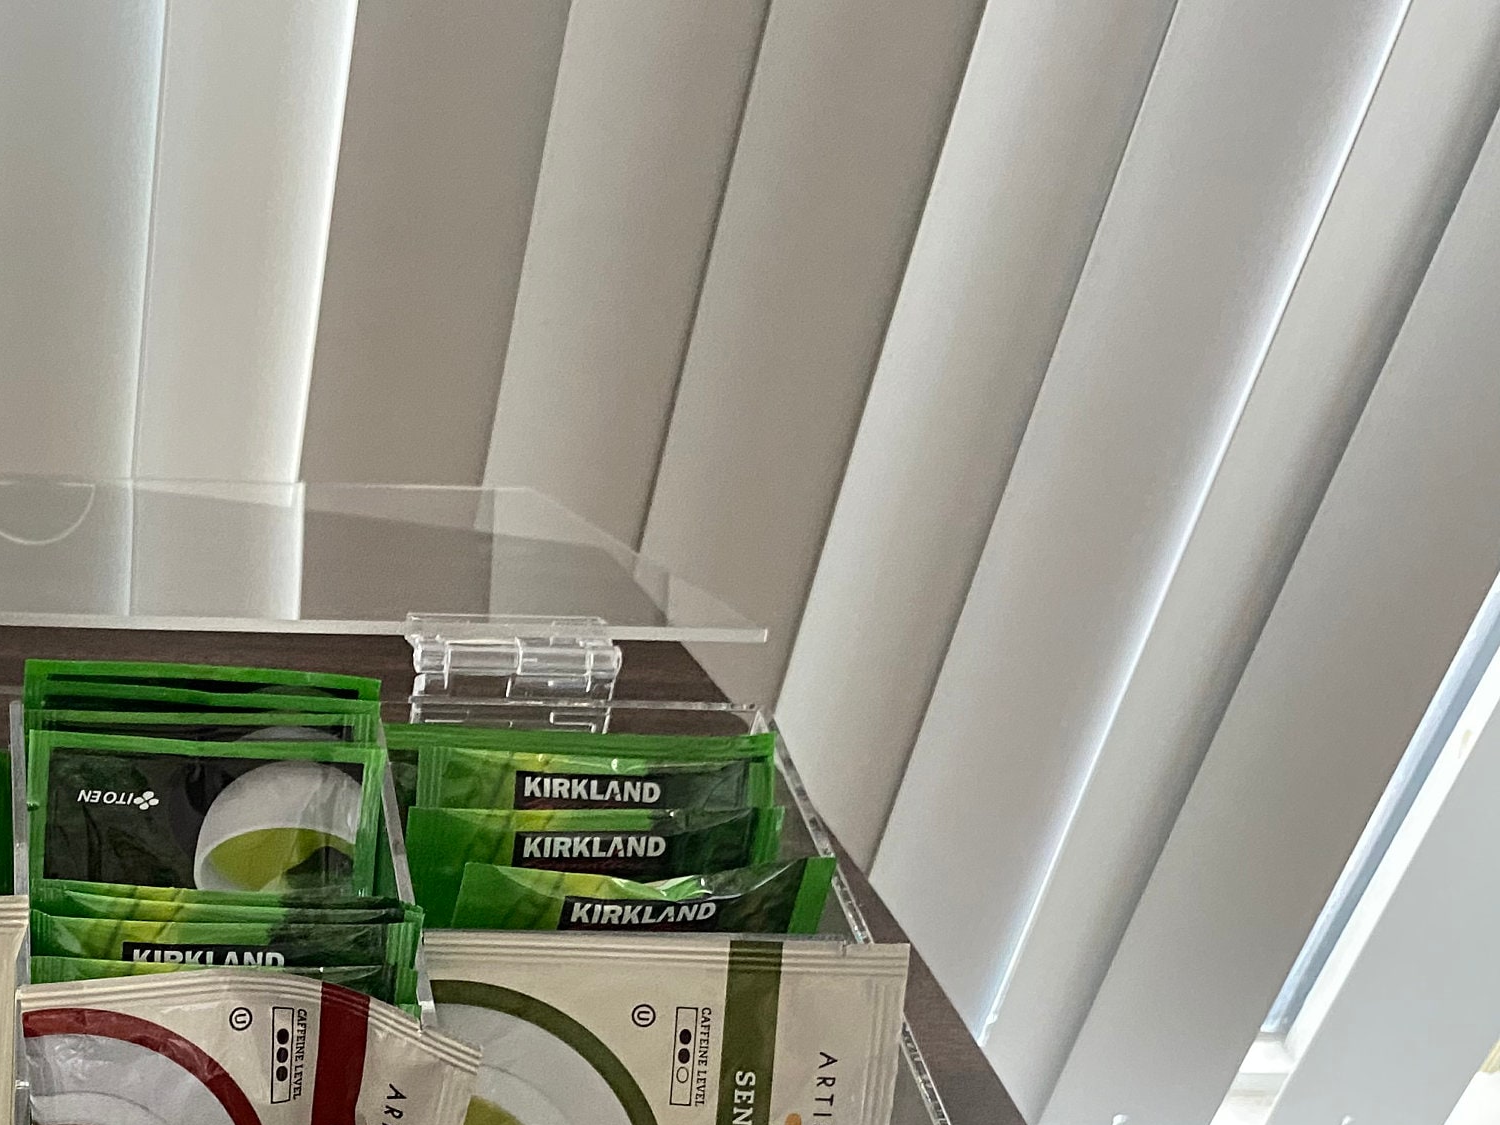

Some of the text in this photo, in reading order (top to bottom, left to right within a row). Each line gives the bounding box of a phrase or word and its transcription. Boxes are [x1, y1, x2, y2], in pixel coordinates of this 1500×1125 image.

[524, 776, 661, 804] KIRKLAND
[523, 836, 667, 858] KIRKLAND
[570, 902, 716, 925] KIRKLAND
[293, 1009, 307, 1100] CAFFEINE LEVEL
[695, 1007, 712, 1107] CAFFEINE LEVEL
